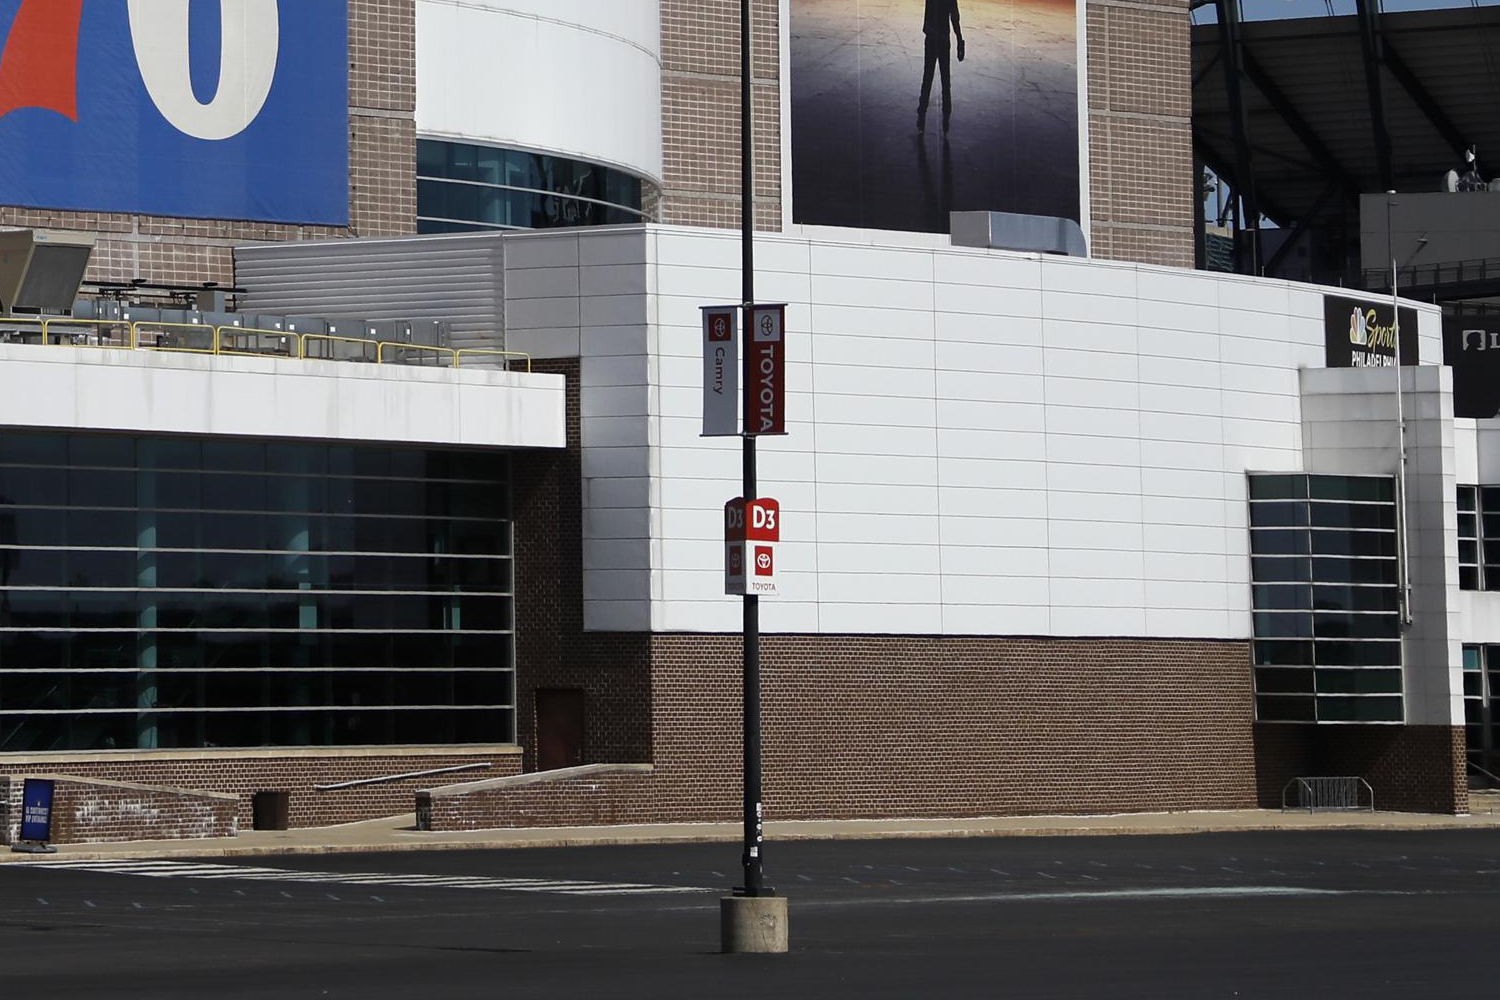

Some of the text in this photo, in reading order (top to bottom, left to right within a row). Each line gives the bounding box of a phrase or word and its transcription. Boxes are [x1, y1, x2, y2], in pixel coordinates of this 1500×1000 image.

[713, 347, 725, 395] Camry
[760, 345, 774, 432] TOYOTA
[728, 506, 744, 529] D3
[753, 505, 775, 529] D3
[752, 582, 776, 591] TOYOTA
